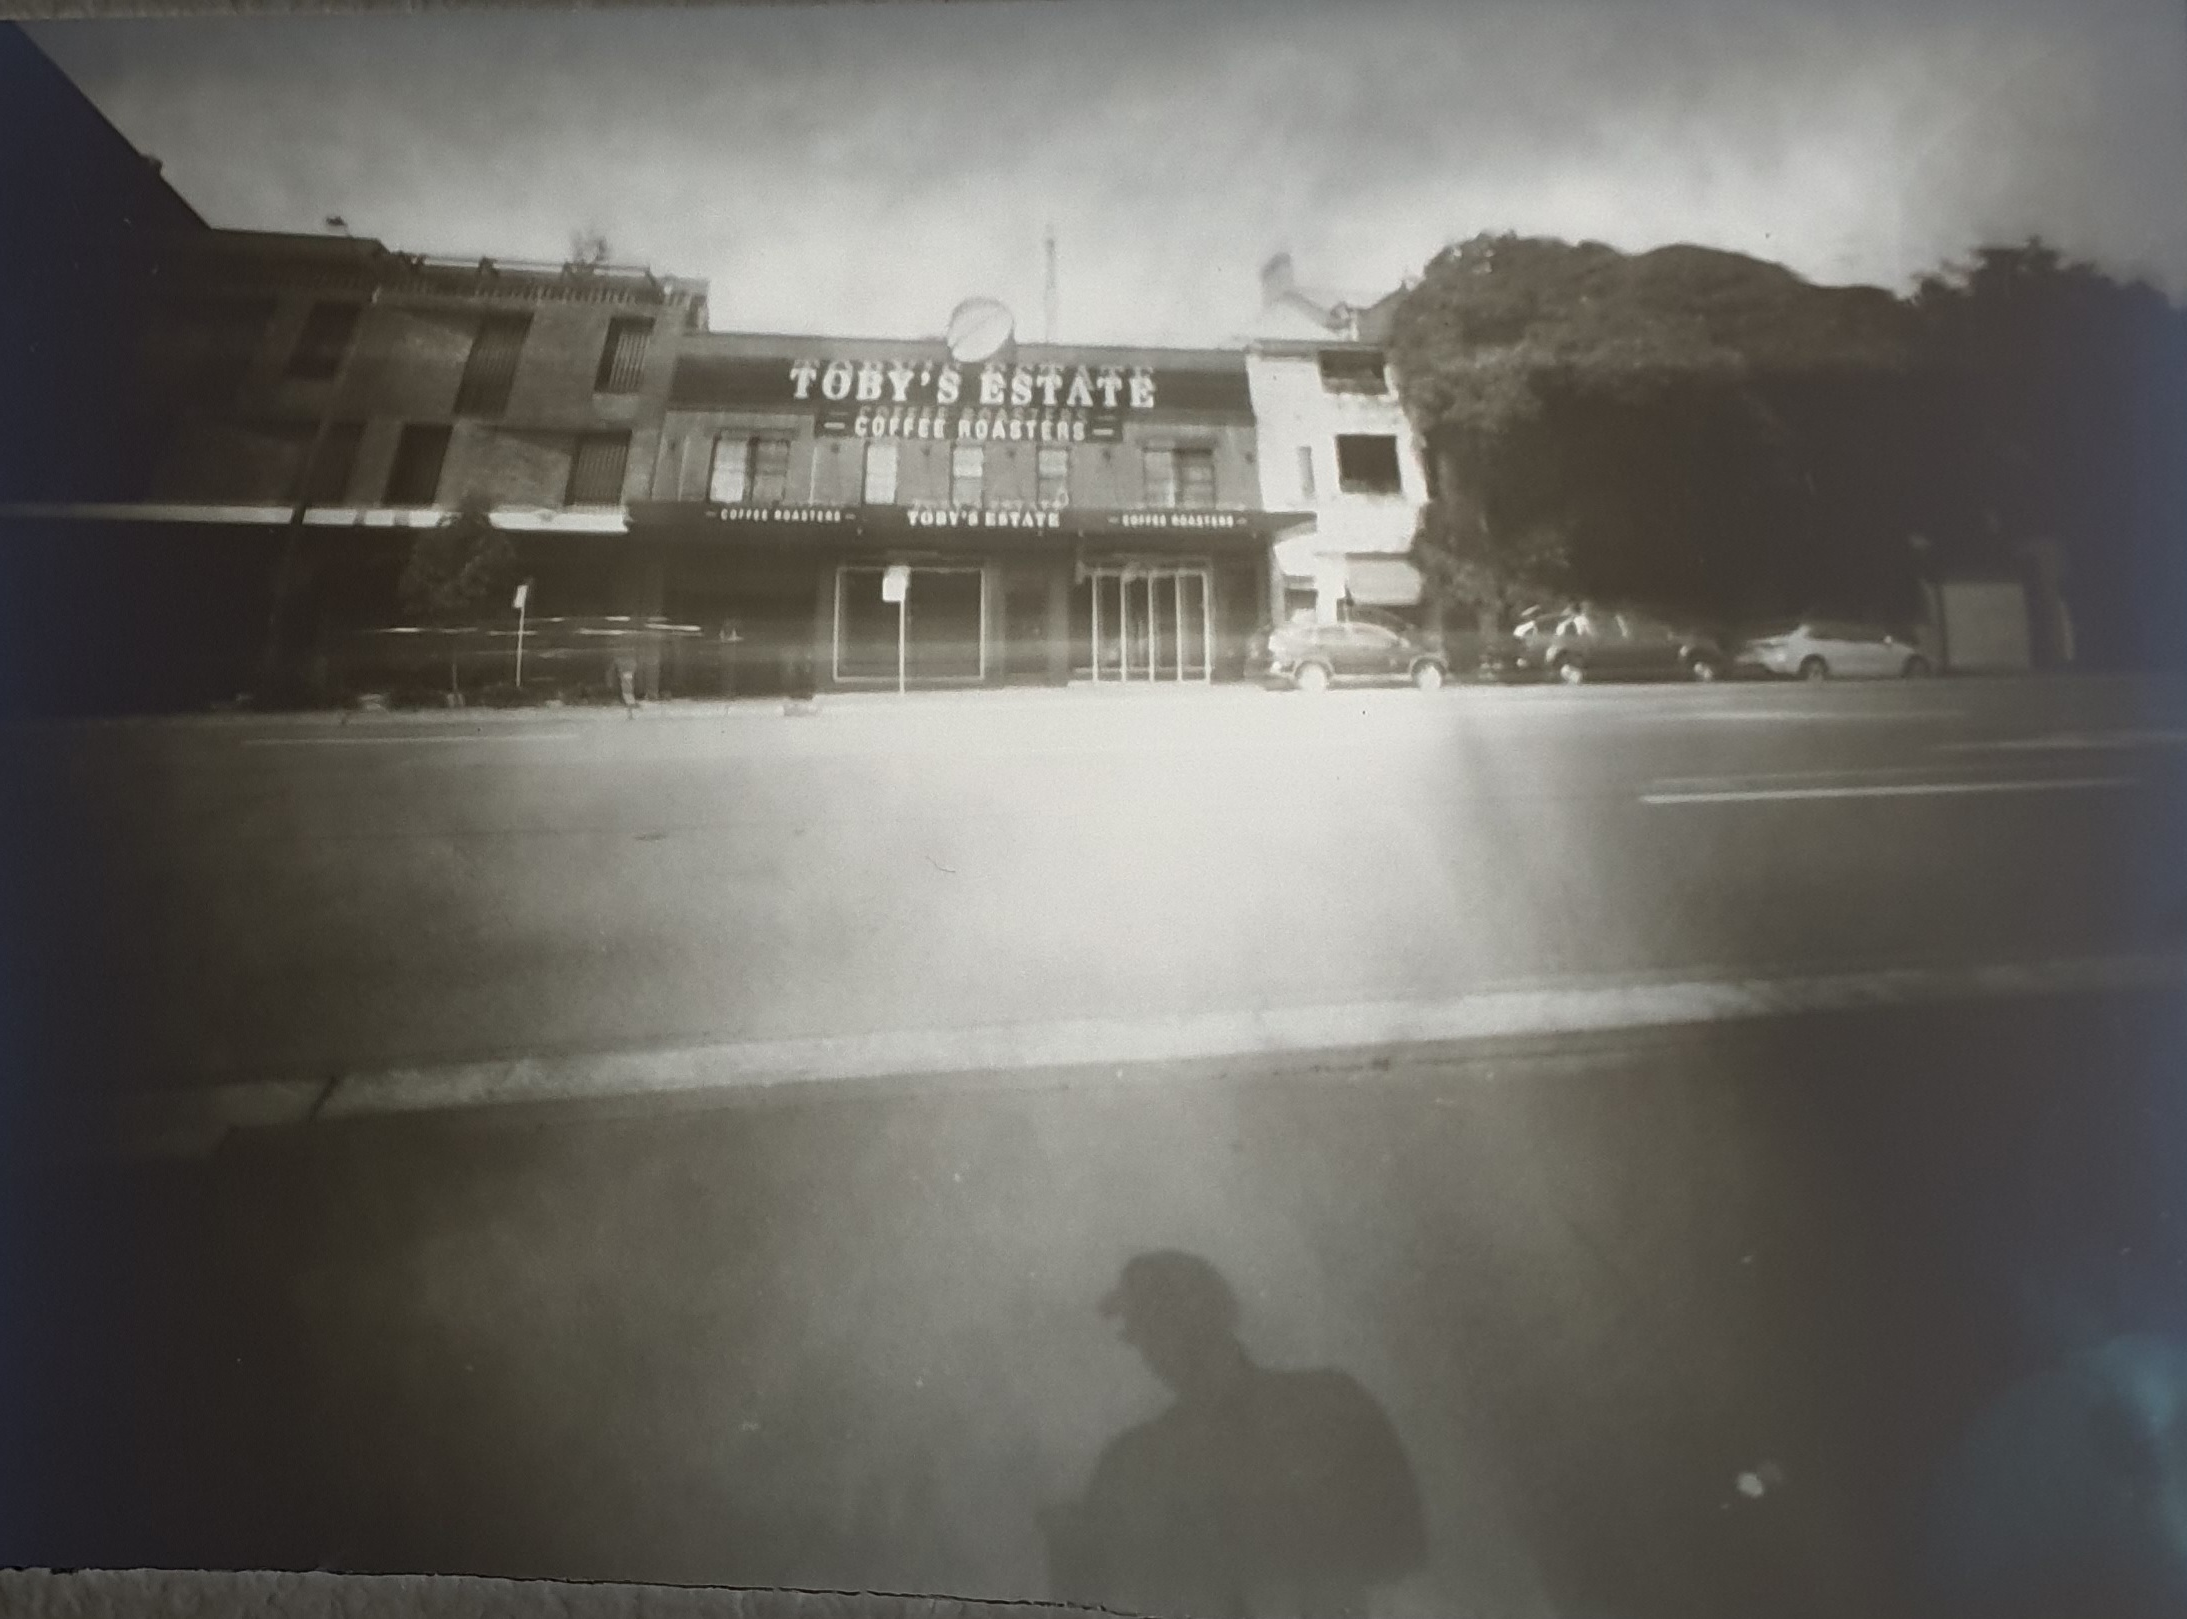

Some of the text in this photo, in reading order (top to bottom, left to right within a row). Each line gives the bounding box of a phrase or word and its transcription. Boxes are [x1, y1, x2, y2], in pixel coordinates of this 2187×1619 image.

[788, 364, 1155, 408] TOBY'S ESTATE
[853, 414, 1086, 441] COFFEE ROASTERS
[906, 510, 1061, 528] TOBY'S ESTATE
